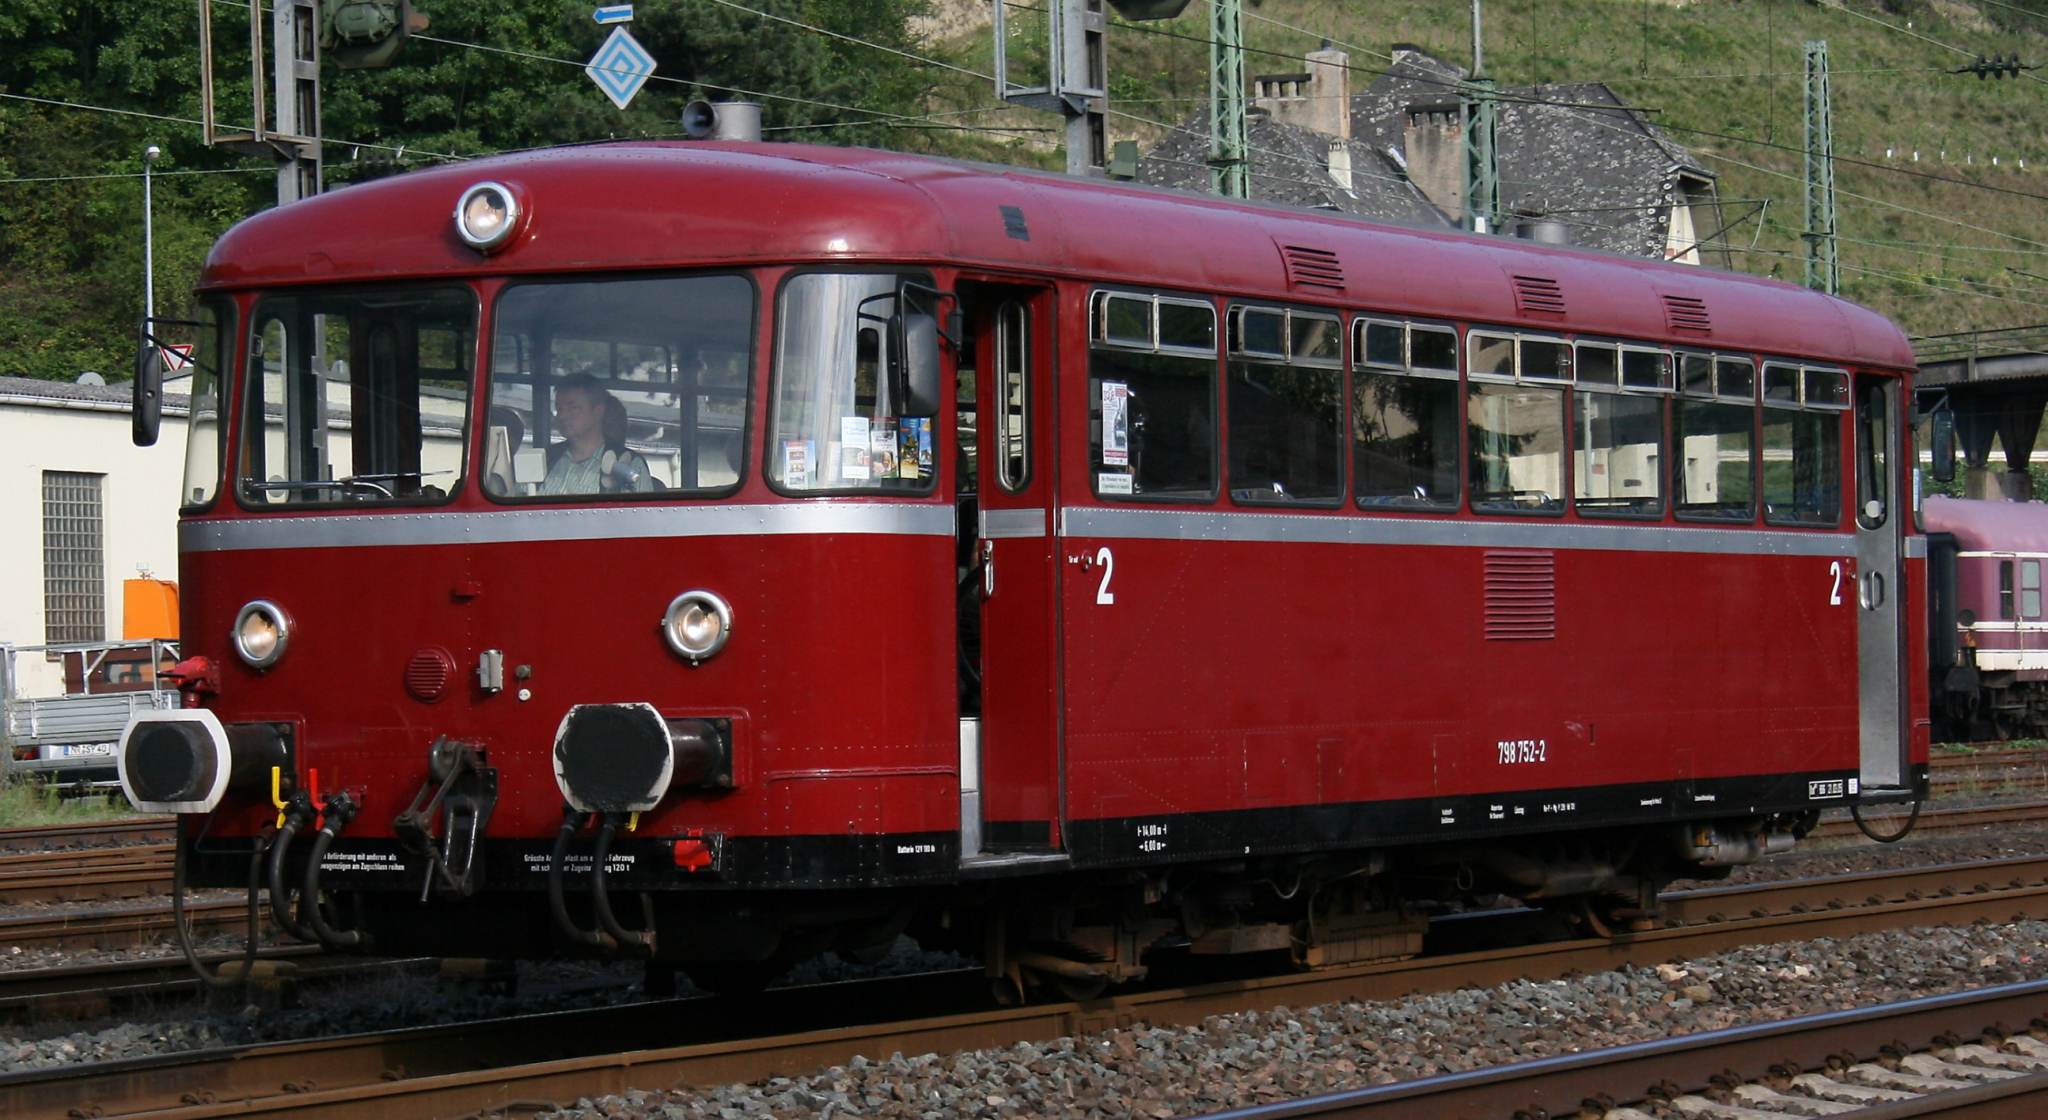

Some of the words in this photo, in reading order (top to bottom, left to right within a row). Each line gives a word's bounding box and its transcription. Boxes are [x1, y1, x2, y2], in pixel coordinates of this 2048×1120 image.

[1096, 547, 1114, 605] 2
[1830, 561, 1841, 605] 2
[1497, 741, 1516, 765] 798
[1517, 740, 1546, 763] 752-2
[388, 853, 397, 861] als
[608, 853, 635, 864] Fahrzeug
[388, 863, 405, 871] reihen
[612, 863, 625, 872] 120
[626, 863, 630, 872] t
